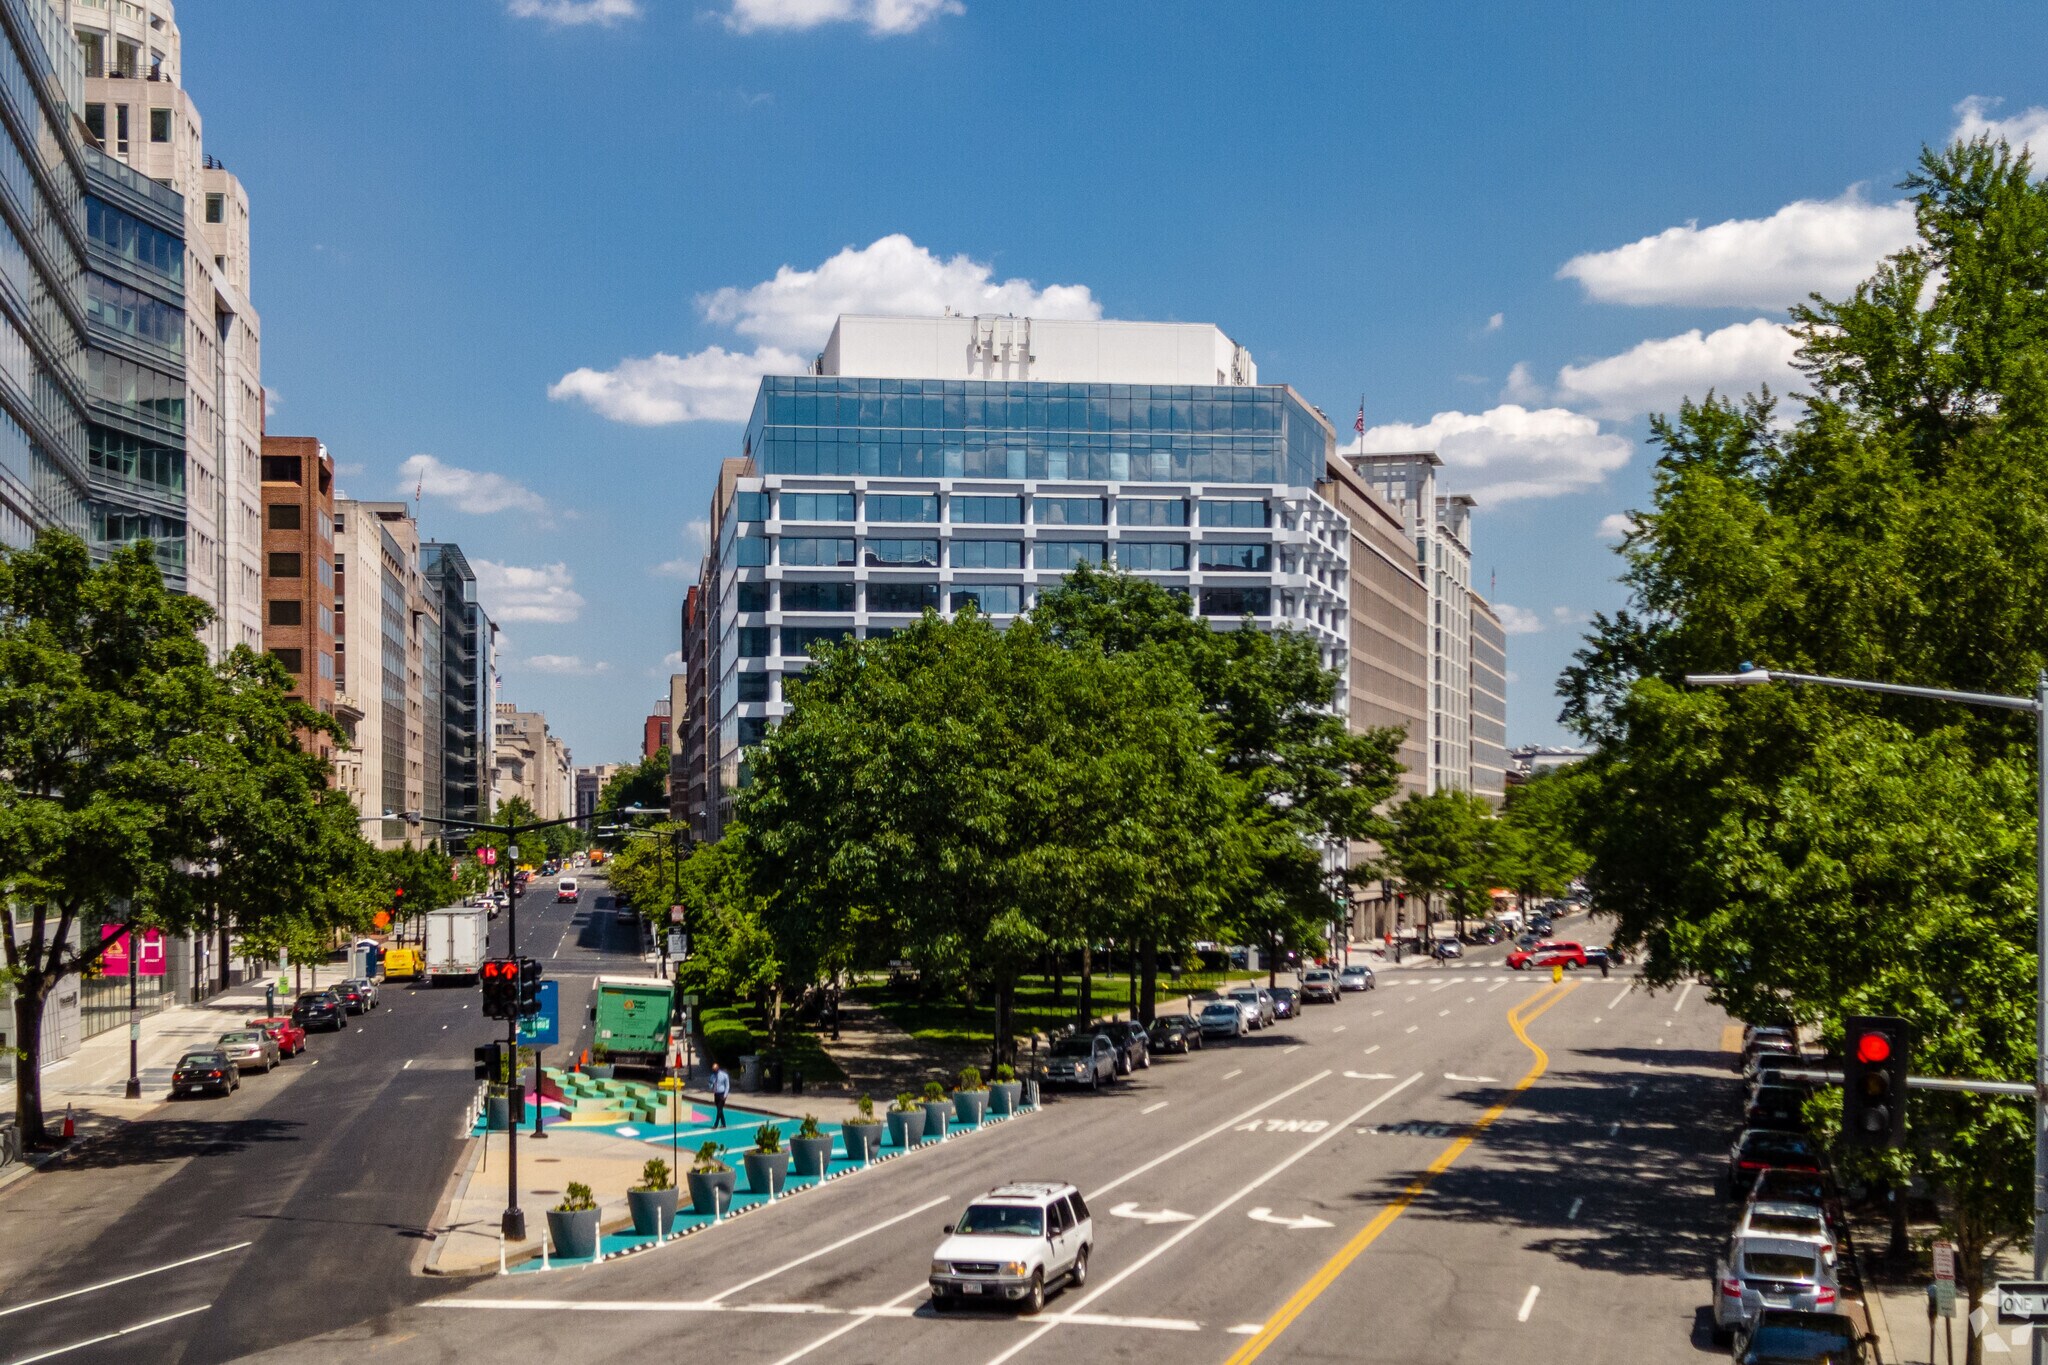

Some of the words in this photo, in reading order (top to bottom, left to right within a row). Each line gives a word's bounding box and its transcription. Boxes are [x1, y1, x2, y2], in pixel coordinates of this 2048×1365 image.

[140, 936, 163, 959] H
[1234, 1119, 1330, 1133] ONLY
[2003, 1297, 2033, 1312] ONE
